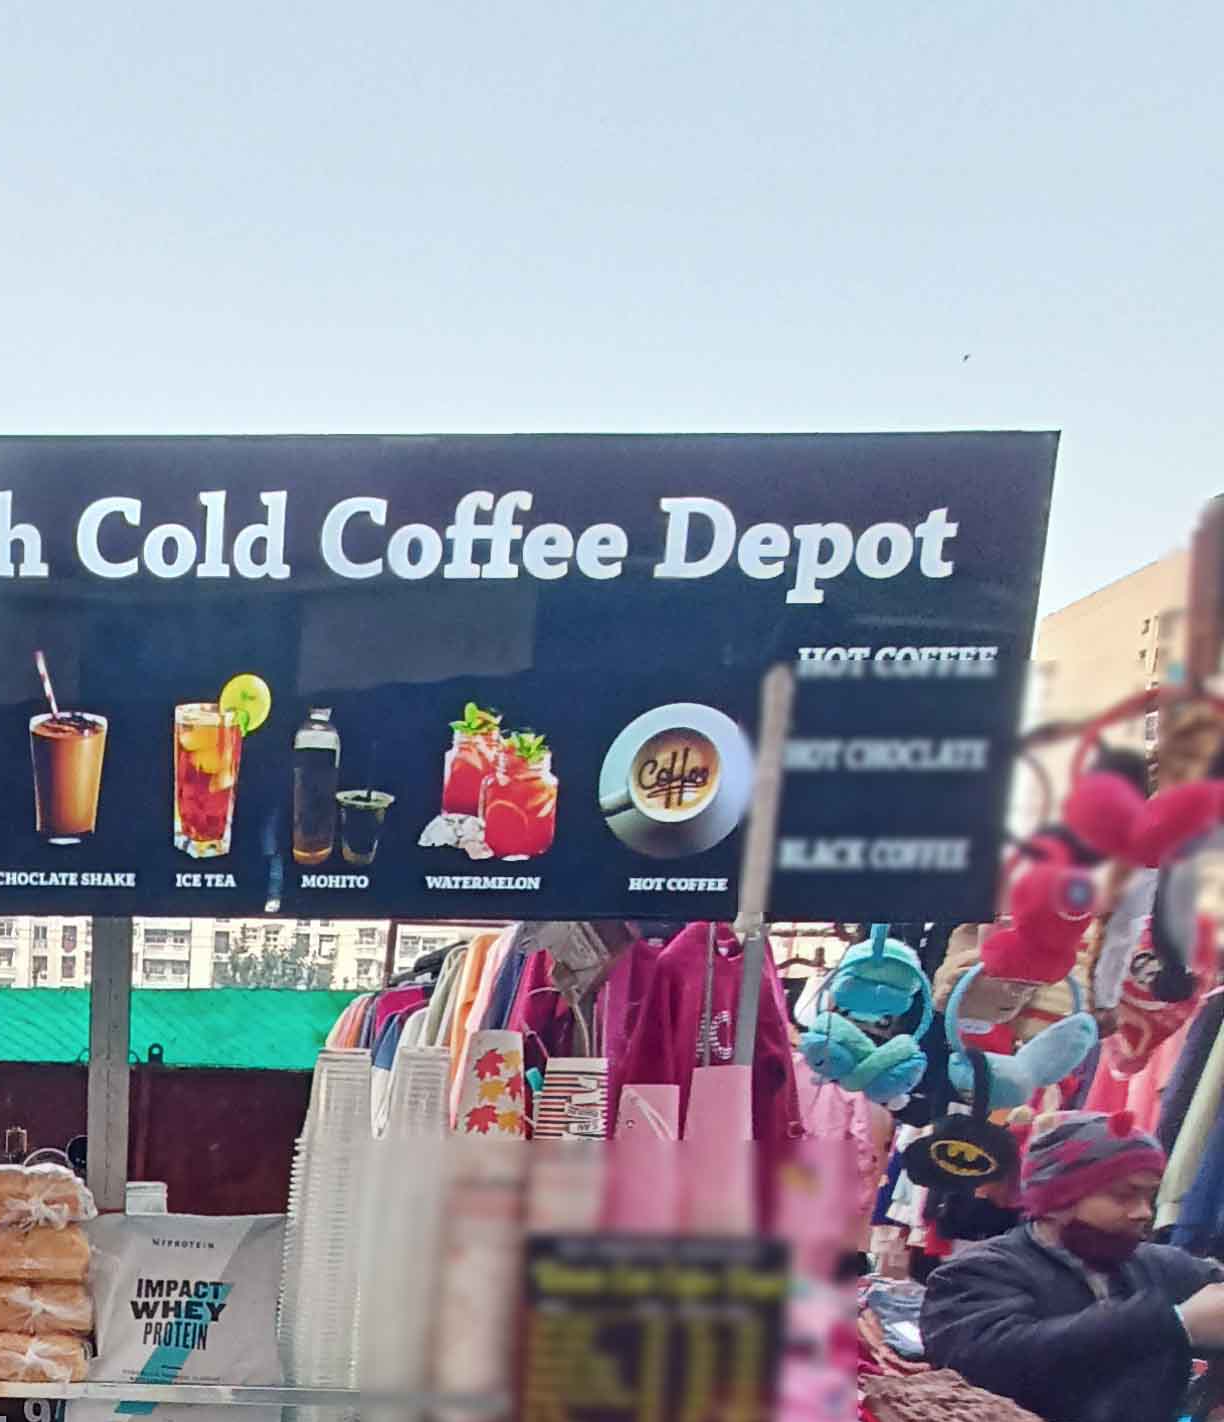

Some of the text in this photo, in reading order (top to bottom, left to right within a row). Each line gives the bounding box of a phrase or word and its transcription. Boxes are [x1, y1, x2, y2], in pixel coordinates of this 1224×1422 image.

[77, 490, 290, 581] Cold
[321, 490, 629, 583] Coffee
[653, 496, 959, 605] Depot
[798, 646, 999, 677] HOT COFFEE
[81, 872, 136, 888] SHAKE
[176, 873, 236, 888] ICE TEA
[300, 874, 369, 889] MOHITO
[424, 875, 542, 891] WATERMELON
[627, 877, 729, 892] HOT COFFEE
[136, 1278, 226, 1299] IMPACT
[130, 1300, 227, 1322] WHEY
[142, 1321, 209, 1350] PROTEIN
